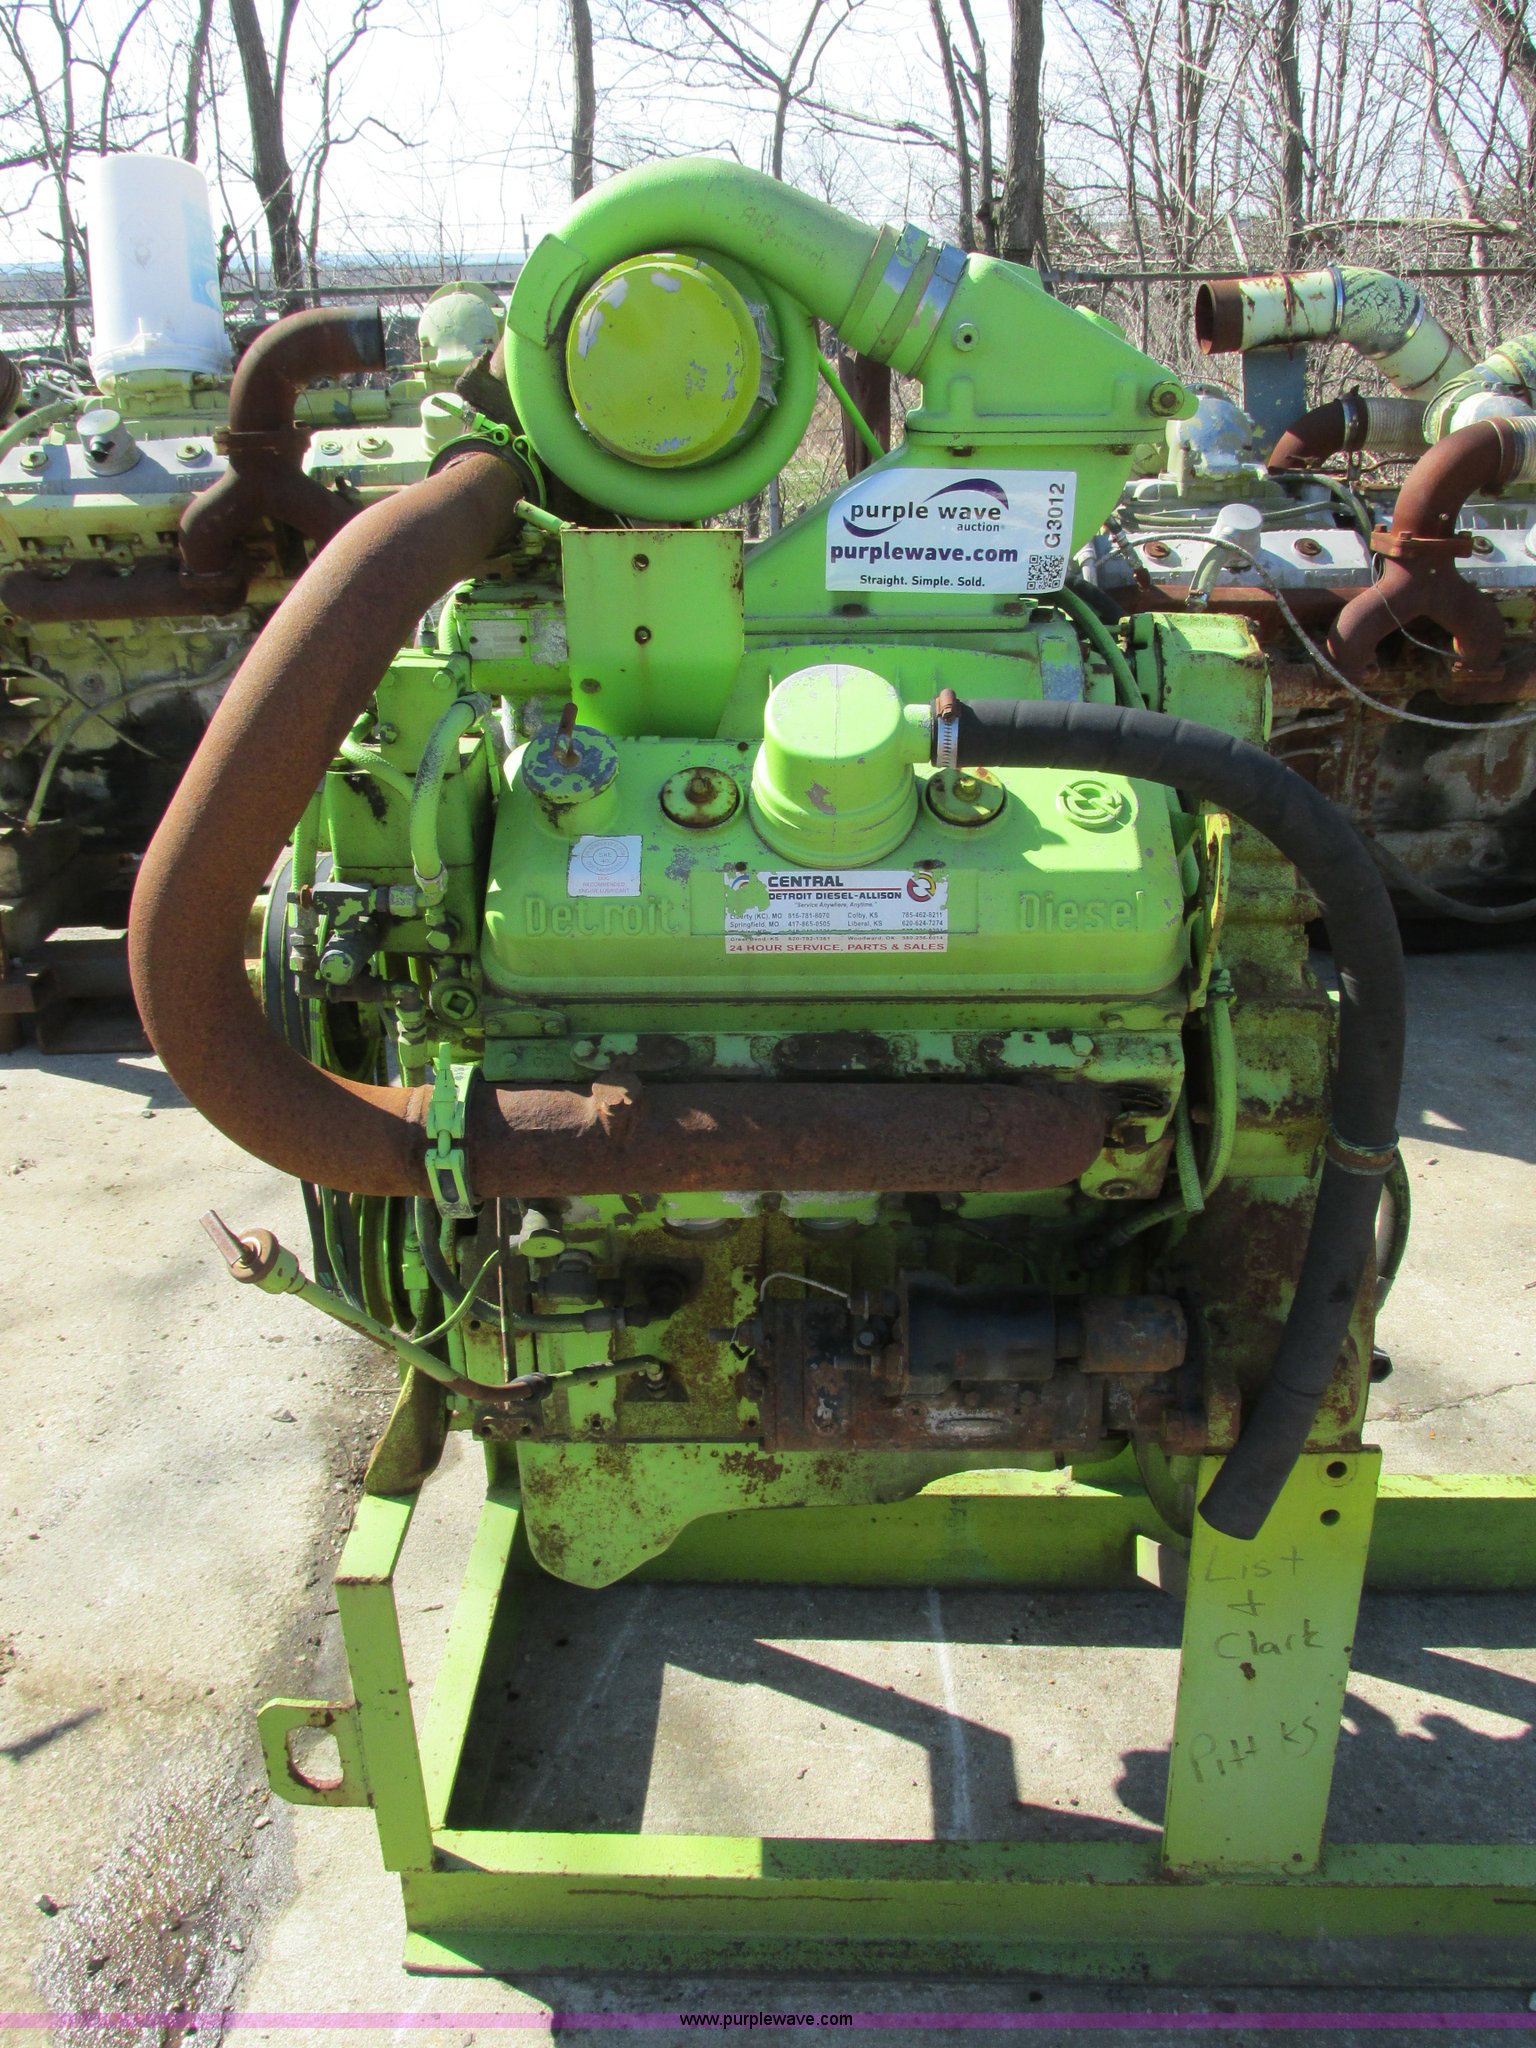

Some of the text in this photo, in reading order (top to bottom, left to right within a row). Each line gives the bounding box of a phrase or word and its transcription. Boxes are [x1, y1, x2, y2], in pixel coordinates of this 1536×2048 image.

[850, 502, 1001, 522] purple wave
[1044, 483, 1065, 548] G3012
[957, 523, 1000, 532] auction
[831, 542, 1018, 563] purplewave.com
[860, 575, 985, 588] Straight. Simple. Sold.
[768, 876, 843, 887] CENTRAL
[769, 892, 901, 900] DETROIT DIESEL-ALLISON
[525, 896, 679, 937] Detroit
[1019, 890, 1144, 933] Diesel
[847, 943, 887, 951] PARTS
[891, 943, 899, 951] &
[903, 943, 945, 951] SALES
[1204, 1545, 1304, 1582] List
[1214, 1617, 1324, 1659] Clark
[1279, 1716, 1318, 1758] KS
